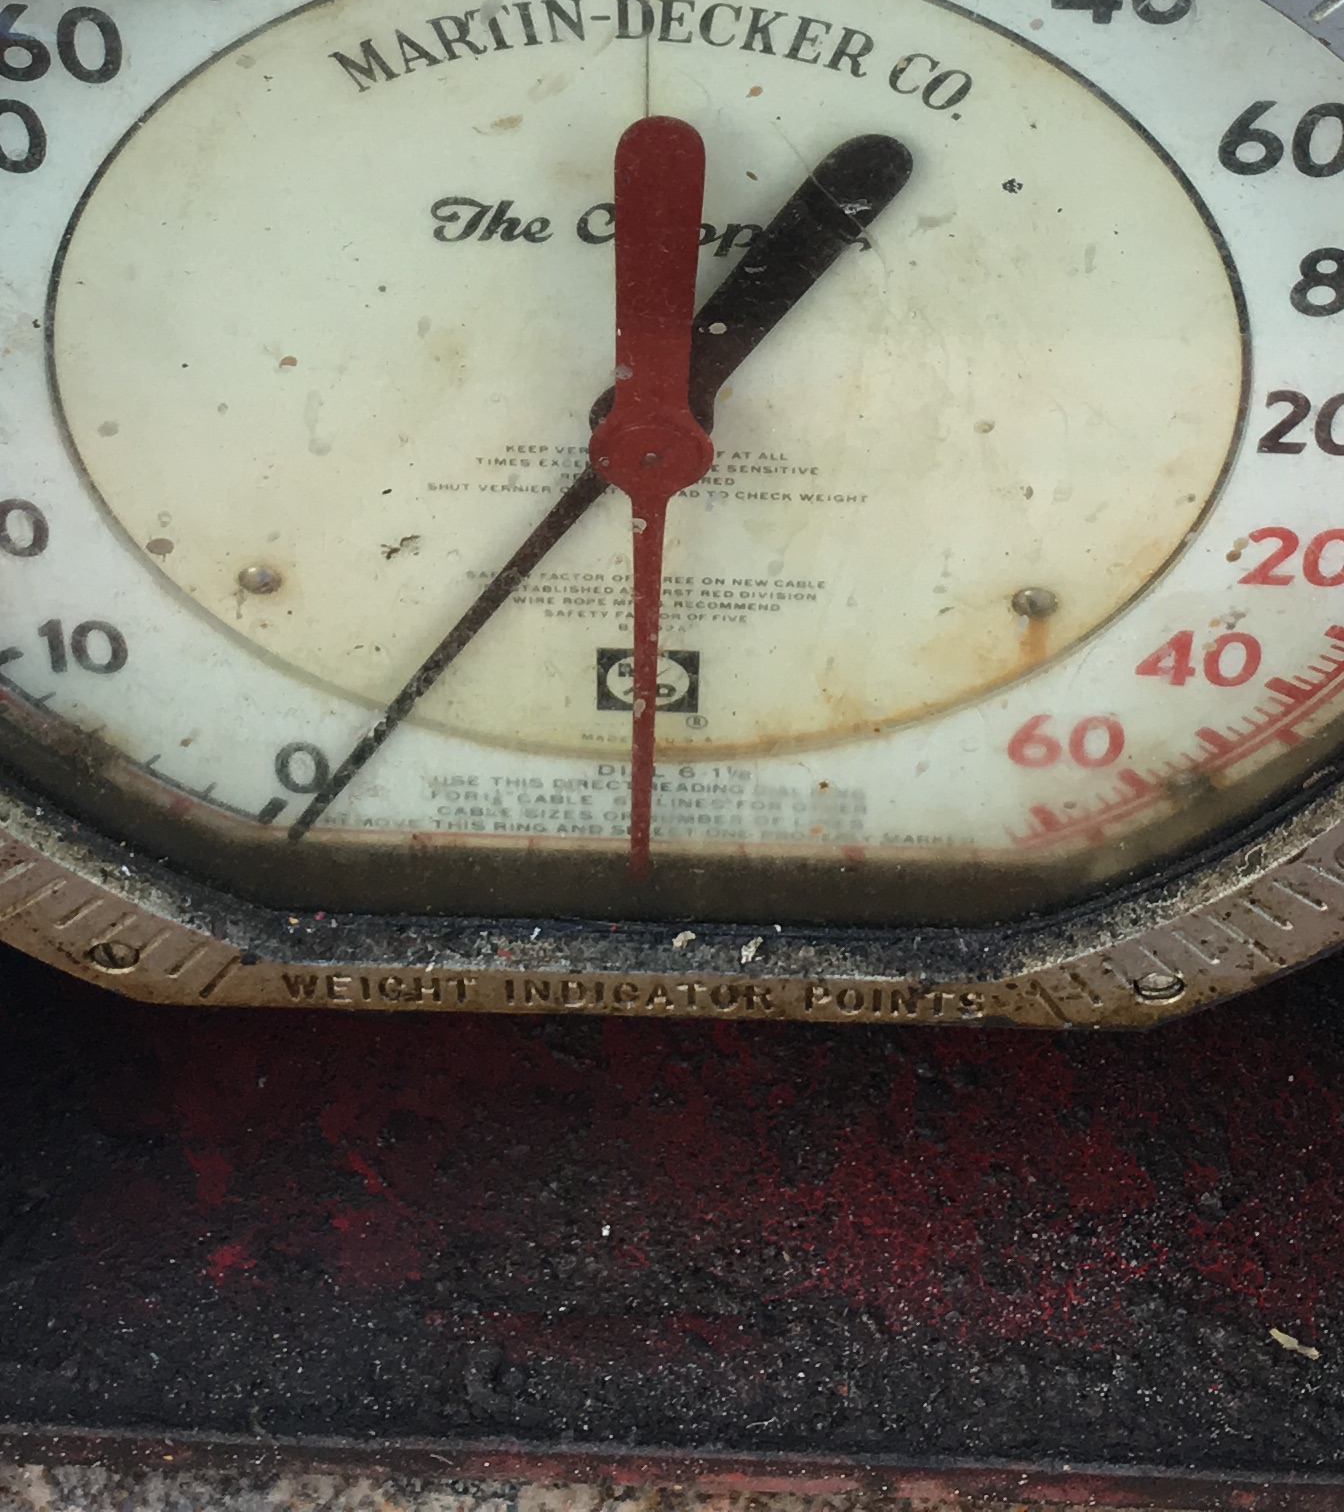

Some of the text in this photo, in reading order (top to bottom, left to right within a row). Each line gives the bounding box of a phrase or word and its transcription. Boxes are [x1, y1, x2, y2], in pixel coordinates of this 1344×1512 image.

[887, 51, 974, 122] CO.
[429, 195, 555, 244] The
[474, 456, 531, 468] TIMES
[726, 464, 819, 476] SENSITIVE
[505, 444, 550, 454] KEEP
[758, 451, 788, 461] ALL
[734, 490, 793, 502] CHECK
[798, 493, 869, 504] WEIGHT
[701, 576, 726, 585] ON
[731, 578, 769, 588] NEW
[773, 579, 827, 589] CABLE
[739, 590, 818, 601] DIVISION
[37, 617, 130, 675] 10
[1133, 627, 1264, 688] 40
[1006, 713, 1127, 771] 60
[274, 741, 332, 795] 0
[280, 971, 987, 1019] WEIGHT INDICATOR POINTS
